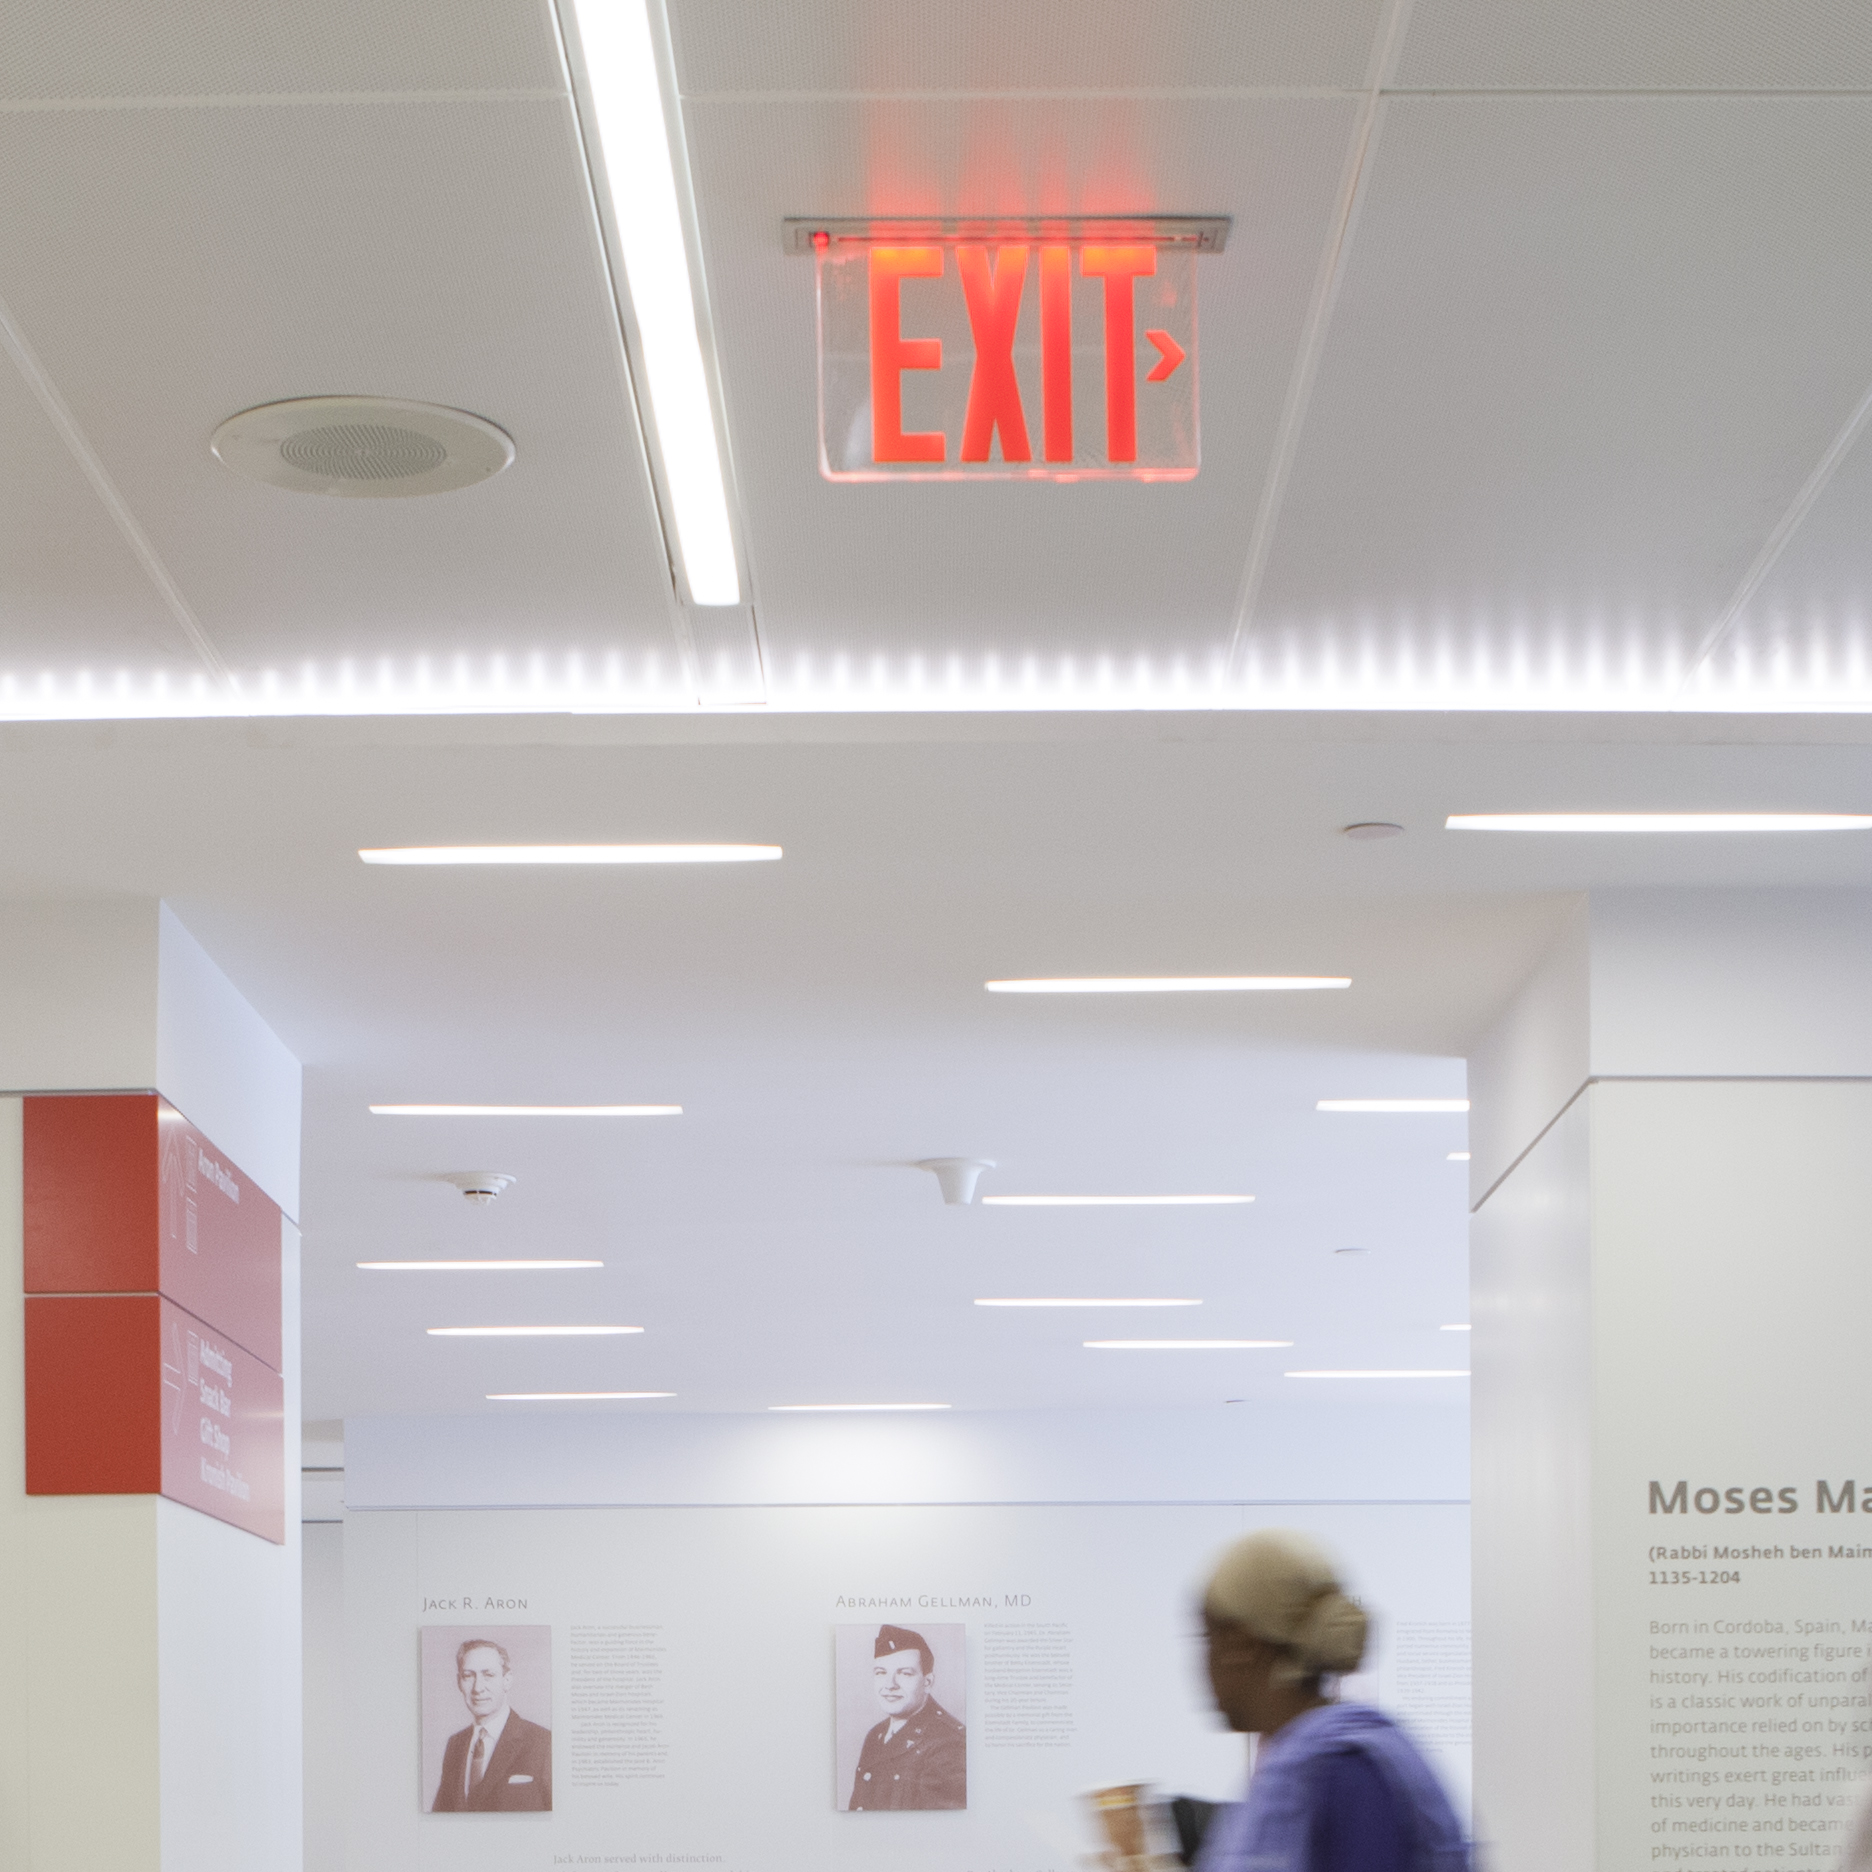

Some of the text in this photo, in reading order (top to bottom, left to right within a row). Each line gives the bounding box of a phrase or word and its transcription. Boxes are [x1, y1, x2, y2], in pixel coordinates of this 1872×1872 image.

[869, 246, 1157, 463] EXIT
[1648, 1480, 1799, 1515] Moses
[1648, 1545, 1708, 1563] (Rabbi
[1713, 1544, 1785, 1560] Mosheh
[1789, 1544, 1823, 1560] ben
[1649, 1570, 1741, 1585] 1135-1204
[462, 1596, 479, 1611] R.
[1004, 1594, 1033, 1608] MD
[1649, 1620, 1690, 1635] Born
[1692, 1621, 1711, 1635] in
[1713, 1619, 1789, 1637] Cordoba,
[1794, 1618, 1846, 1636] Spain,
[1649, 1644, 1716, 1660] became
[1719, 1647, 1729, 1659] a
[1733, 1645, 1810, 1663] towering
[1813, 1642, 1862, 1662] figure
[1649, 1669, 1711, 1687] history.
[1717, 1670, 1745, 1684] His
[1747, 1667, 1847, 1684] codification
[1850, 1667, 1869, 1683] of
[1649, 1694, 1665, 1709] is
[1667, 1697, 1678, 1709] a
[1681, 1694, 1736, 1709] classic
[1740, 1694, 1783, 1709] work
[1786, 1693, 1805, 1708] of
[1650, 1720, 1748, 1737] importance
[1751, 1718, 1798, 1734] relied
[1801, 1720, 1824, 1733] on
[1827, 1718, 1848, 1735] by
[1649, 1744, 1748, 1762] throughout
[1751, 1743, 1780, 1758] the
[1783, 1745, 1827, 1762] ages.
[1832, 1743, 1860, 1758] His
[1649, 1770, 1720, 1787] writings
[1724, 1770, 1768, 1784] exert
[1771, 1769, 1816, 1787] great
[1650, 1793, 1683, 1809] this
[1686, 1796, 1722, 1811] very
[1764, 1793, 1788, 1808] He
[1791, 1792, 1822, 1807] had
[1650, 1817, 1668, 1834] of
[1672, 1818, 1749, 1833] medicine
[1751, 1817, 1784, 1832] and
[553, 1852, 726, 1865] Jack Aron served with distinction.
[1651, 1843, 1730, 1862] physician
[1733, 1844, 1753, 1858] to
[1756, 1842, 1785, 1857] the
